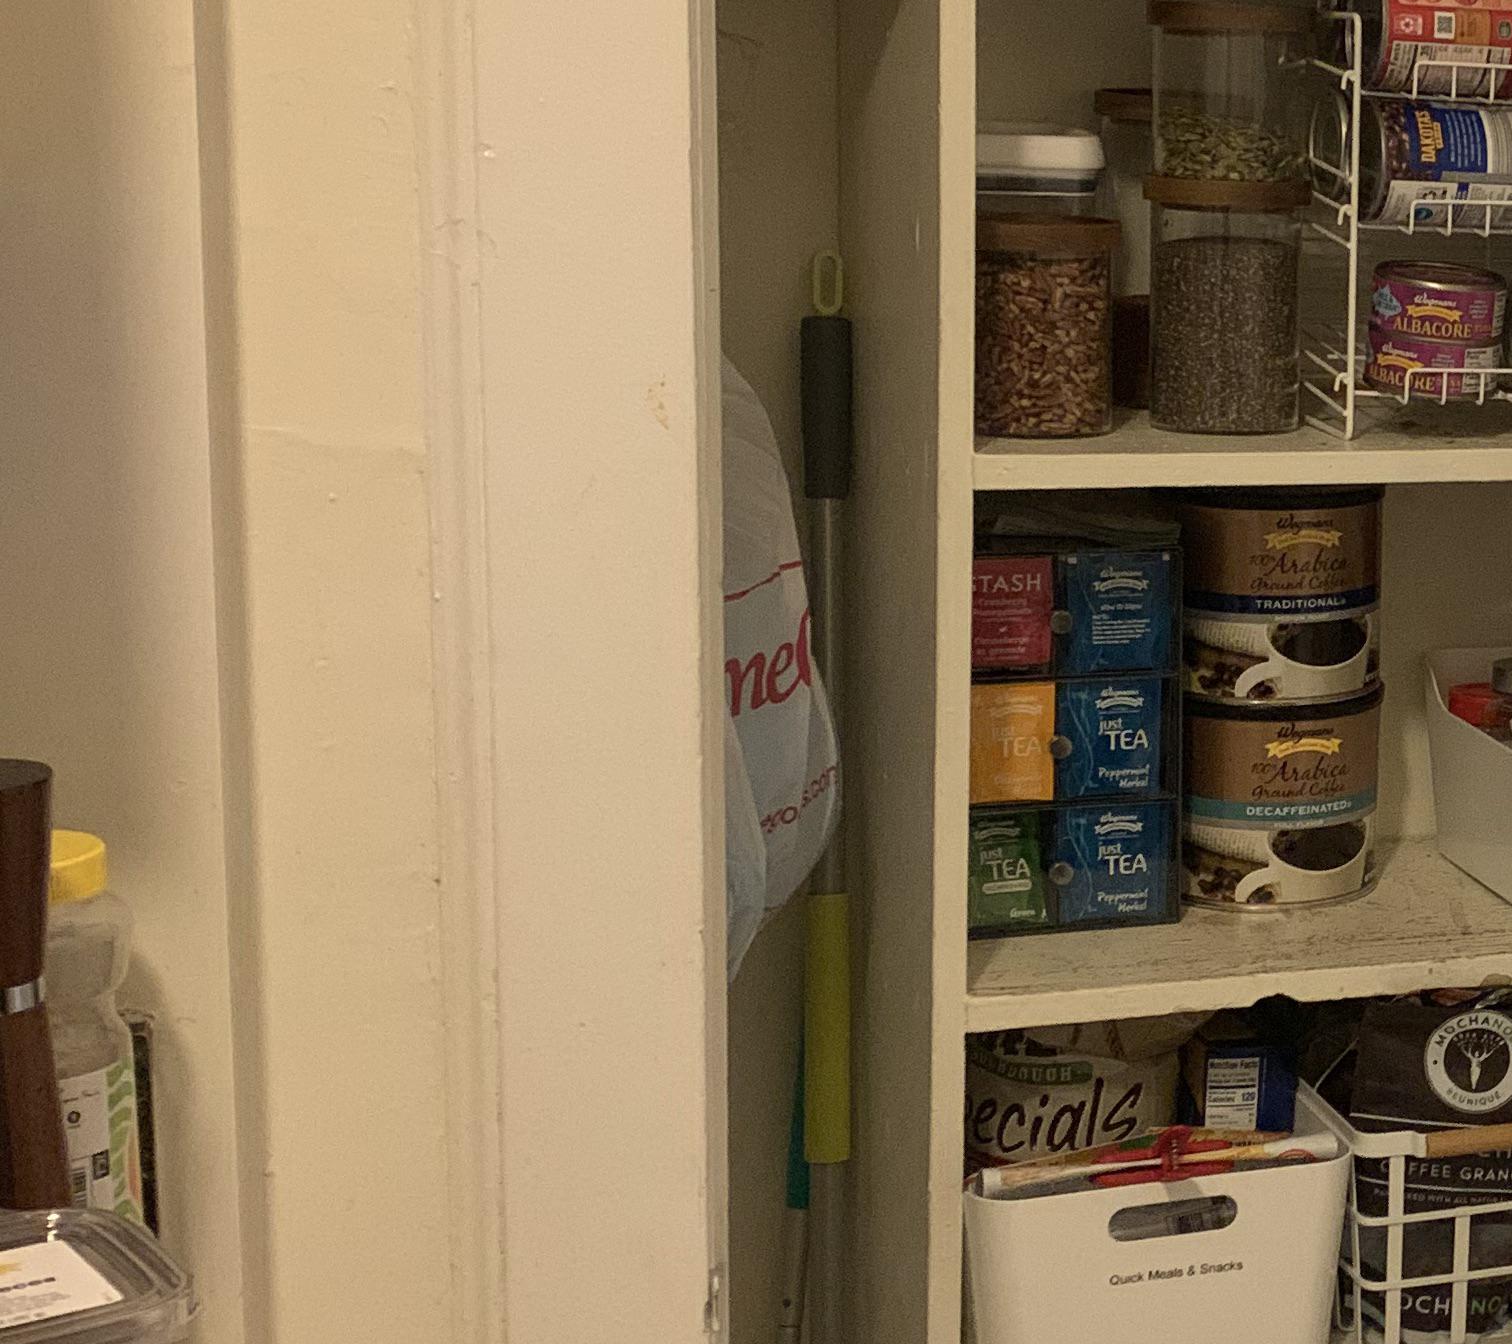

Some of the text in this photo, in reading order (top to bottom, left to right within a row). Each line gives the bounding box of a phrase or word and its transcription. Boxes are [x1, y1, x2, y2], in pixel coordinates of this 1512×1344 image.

[1414, 292, 1457, 308] Wegmans
[1393, 315, 1473, 338] ALBACORE
[1275, 513, 1334, 535] Wegmans
[1264, 548, 1351, 577] Arabica
[1250, 574, 1346, 593] Ground Coffee
[1255, 598, 1340, 611] TRADITIONAL
[1098, 716, 1124, 735] just
[1276, 722, 1335, 742] Wegmans
[1001, 736, 1042, 758] TEA
[1105, 729, 1149, 751] TEA
[1098, 764, 1150, 779] Peppermint
[1265, 755, 1350, 784] Arabica
[1251, 782, 1346, 801] Ground Coffee
[1246, 800, 1348, 816] DECAFFEINATED
[1097, 841, 1123, 860] just
[986, 857, 1032, 881] TEA
[1104, 852, 1148, 876] TEA
[1097, 888, 1149, 903] Peppermint
[966, 1076, 1144, 1154] ecials
[1380, 1162, 1451, 1179] CFFEE
[1109, 1261, 1243, 1287] Quick Meals & Snacks
